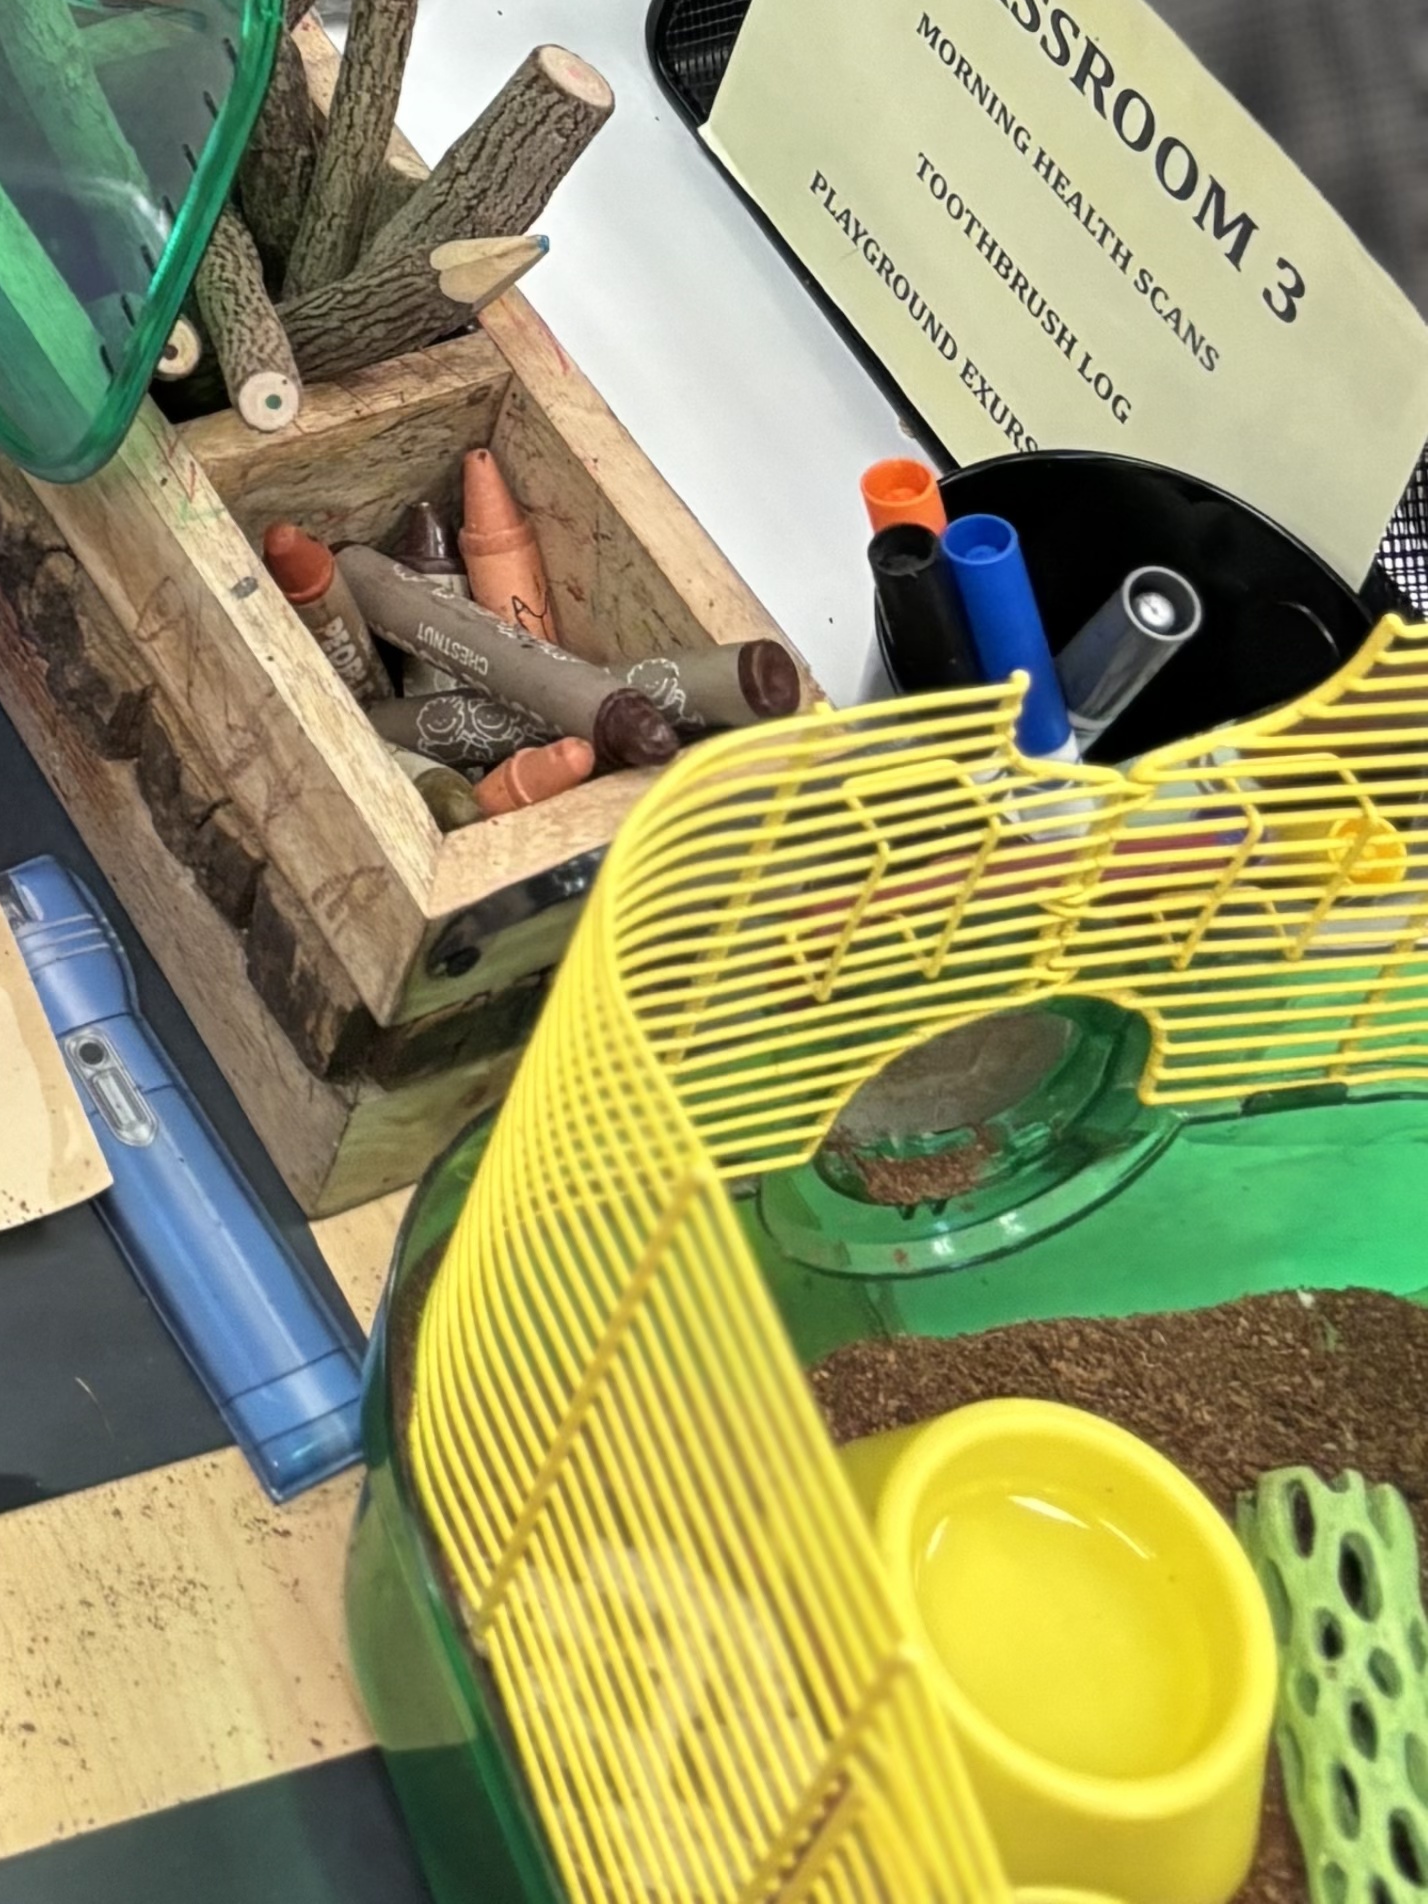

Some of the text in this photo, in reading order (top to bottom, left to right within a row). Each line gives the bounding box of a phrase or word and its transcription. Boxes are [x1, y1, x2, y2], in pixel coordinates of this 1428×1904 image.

[809, 169, 958, 361] PLAYGROUND
[916, 12, 1220, 373] MORNING HEALTH SCANS
[916, 152, 1132, 424] TOOTHBRUSH LOG
[1262, 256, 1306, 324] 3
[417, 622, 489, 676] CHESTNUT
